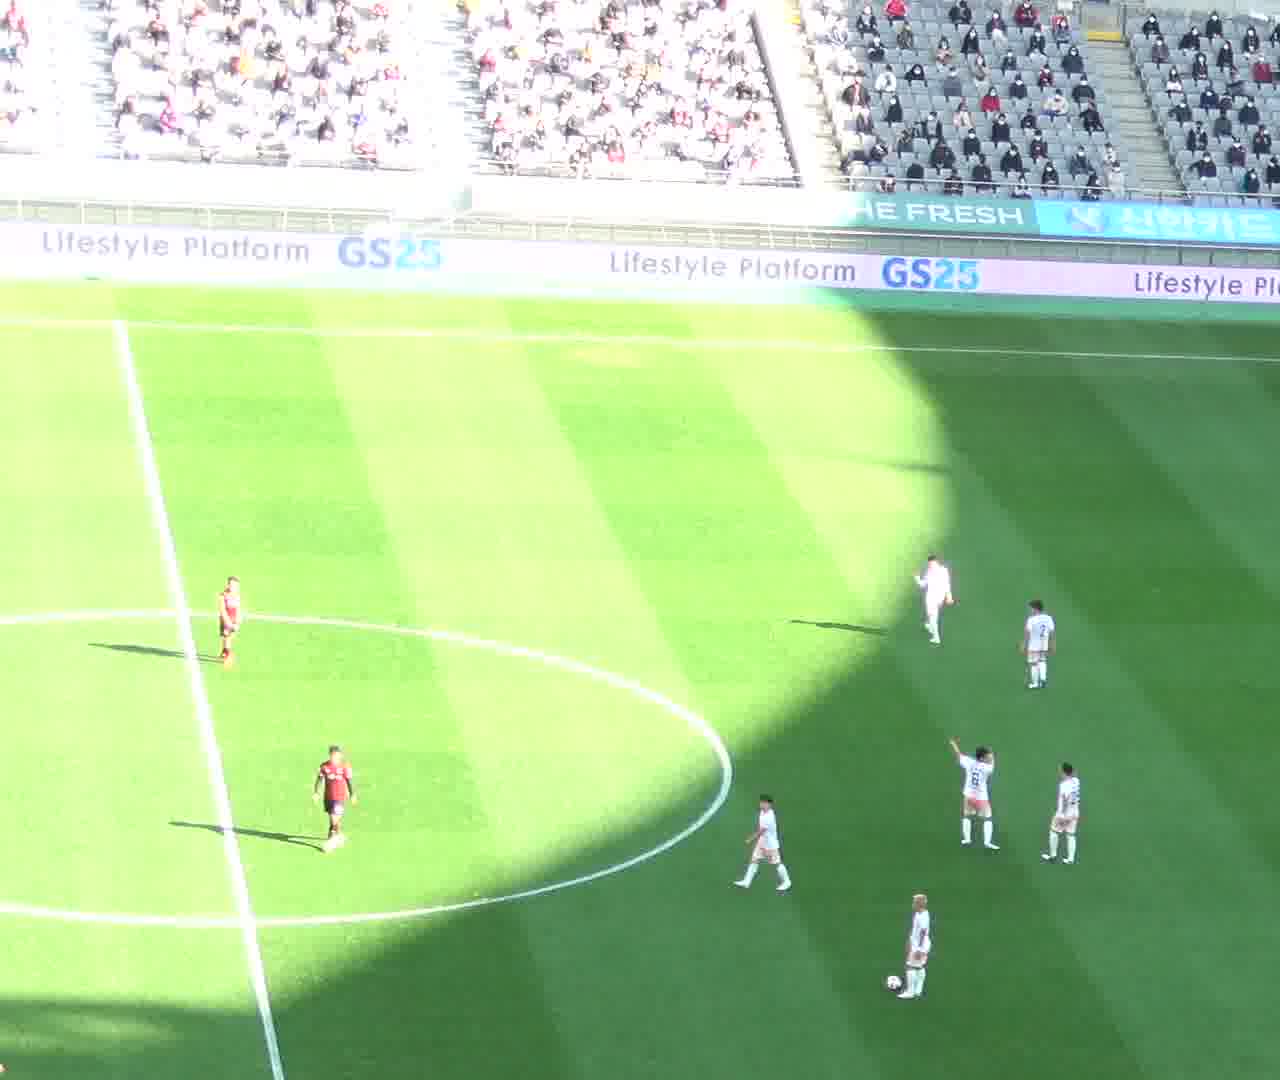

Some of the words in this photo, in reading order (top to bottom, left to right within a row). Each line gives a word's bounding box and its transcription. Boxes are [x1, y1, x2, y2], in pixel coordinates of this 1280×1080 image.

[905, 203, 1025, 225] FRESH
[42, 230, 169, 257] Lifestyle
[184, 235, 310, 262] Platform
[337, 237, 445, 268] GS25
[609, 250, 728, 279] Lifestyle
[739, 255, 856, 282] Platform
[881, 256, 981, 289] GS25
[1134, 271, 1243, 301] Lifestyle
